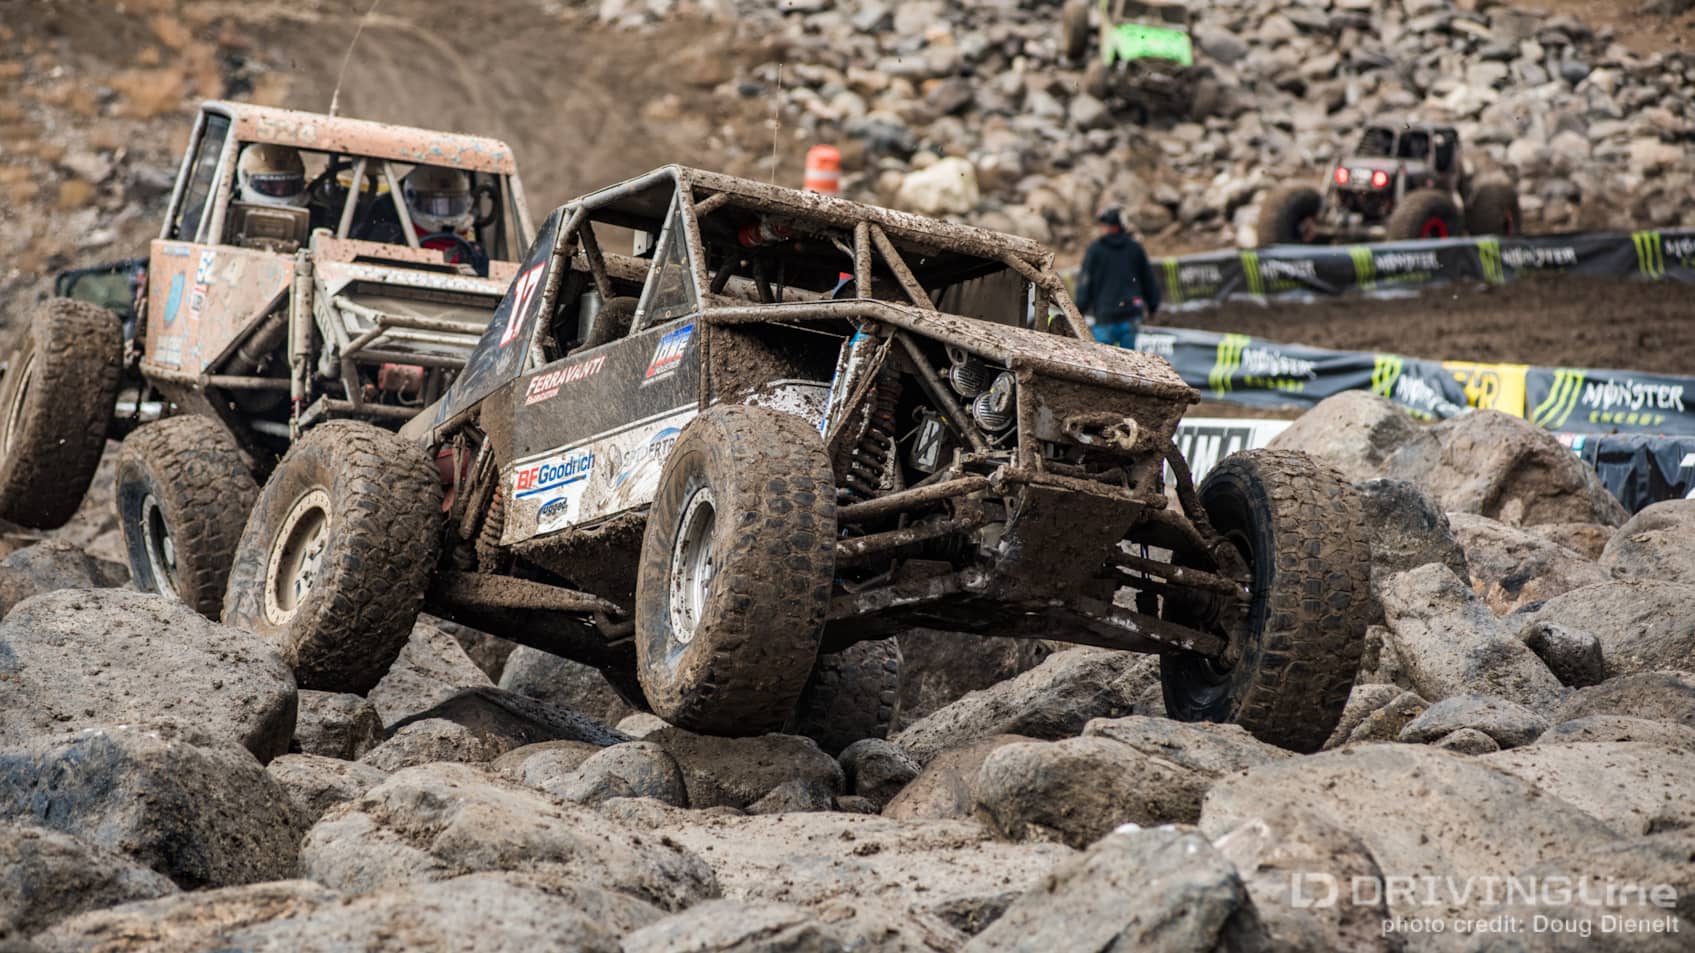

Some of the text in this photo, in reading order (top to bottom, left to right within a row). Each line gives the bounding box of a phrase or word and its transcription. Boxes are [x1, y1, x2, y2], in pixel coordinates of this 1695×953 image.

[499, 261, 545, 347] 17
[525, 356, 606, 397] FERRAVANTI
[1582, 377, 1684, 412] MONSTER
[1588, 410, 1665, 427] ENERGY
[516, 449, 596, 491] BFGoodrich
